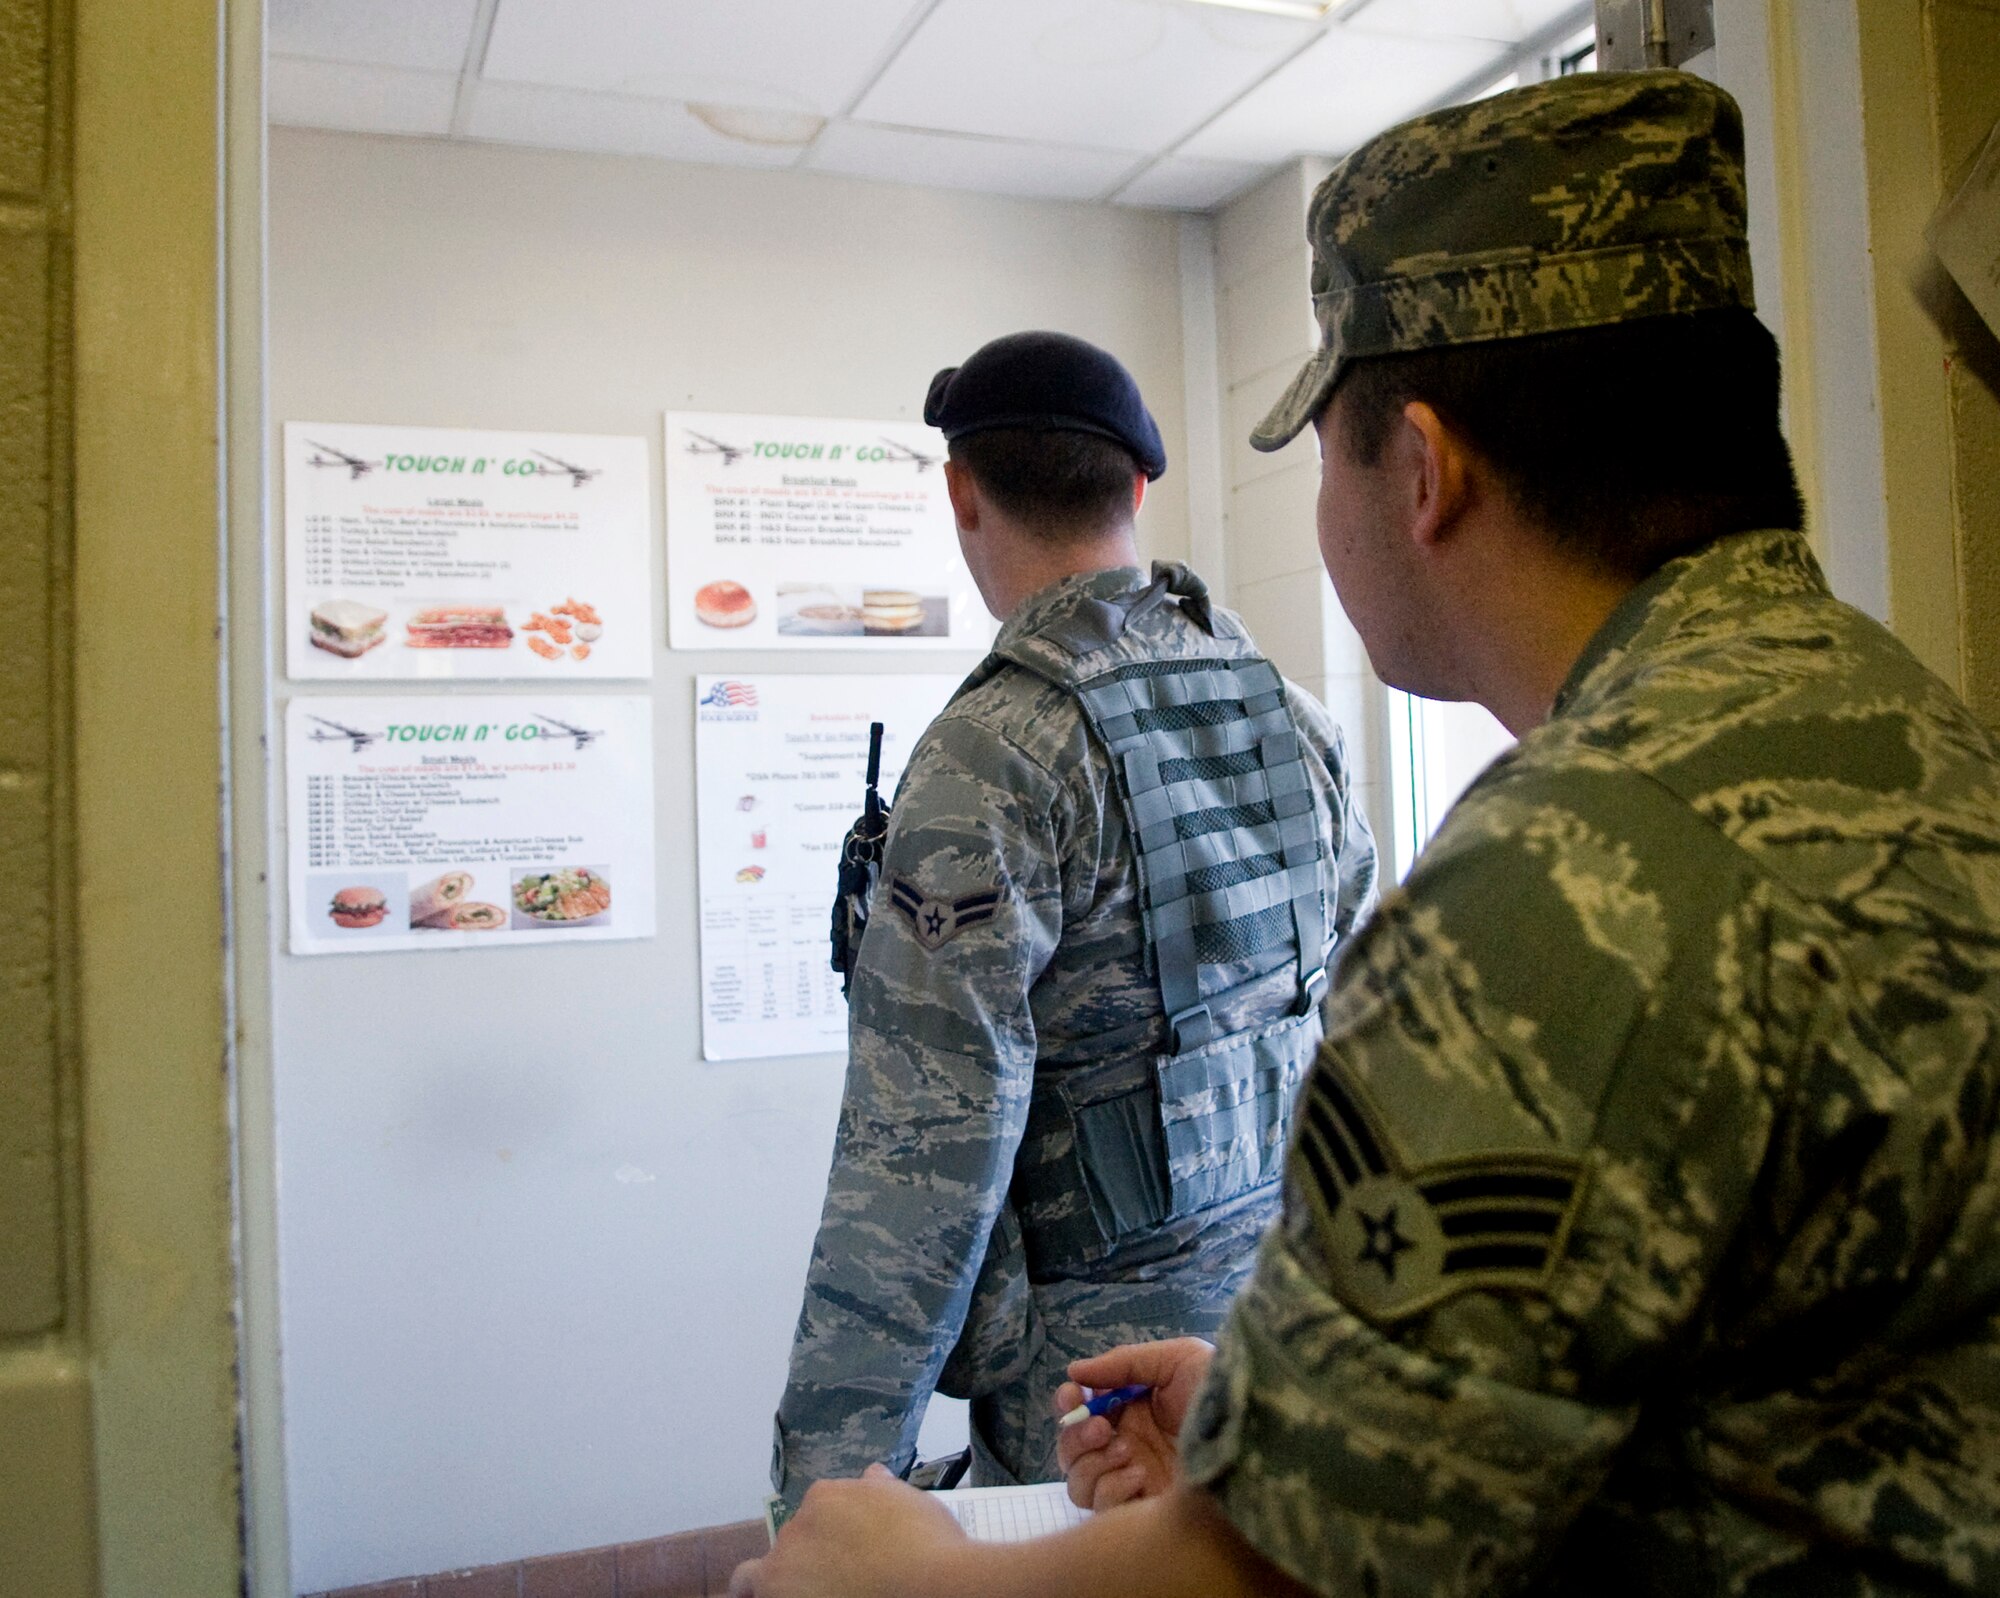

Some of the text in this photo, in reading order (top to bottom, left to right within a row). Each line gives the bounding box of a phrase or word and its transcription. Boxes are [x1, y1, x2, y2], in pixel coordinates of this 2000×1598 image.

[752, 441, 824, 460] TOUCH
[856, 446, 886, 462] GO
[384, 454, 466, 473] TOUCH
[502, 458, 537, 476] GO
[386, 724, 468, 742] TOUCH
[505, 724, 539, 741] GO
